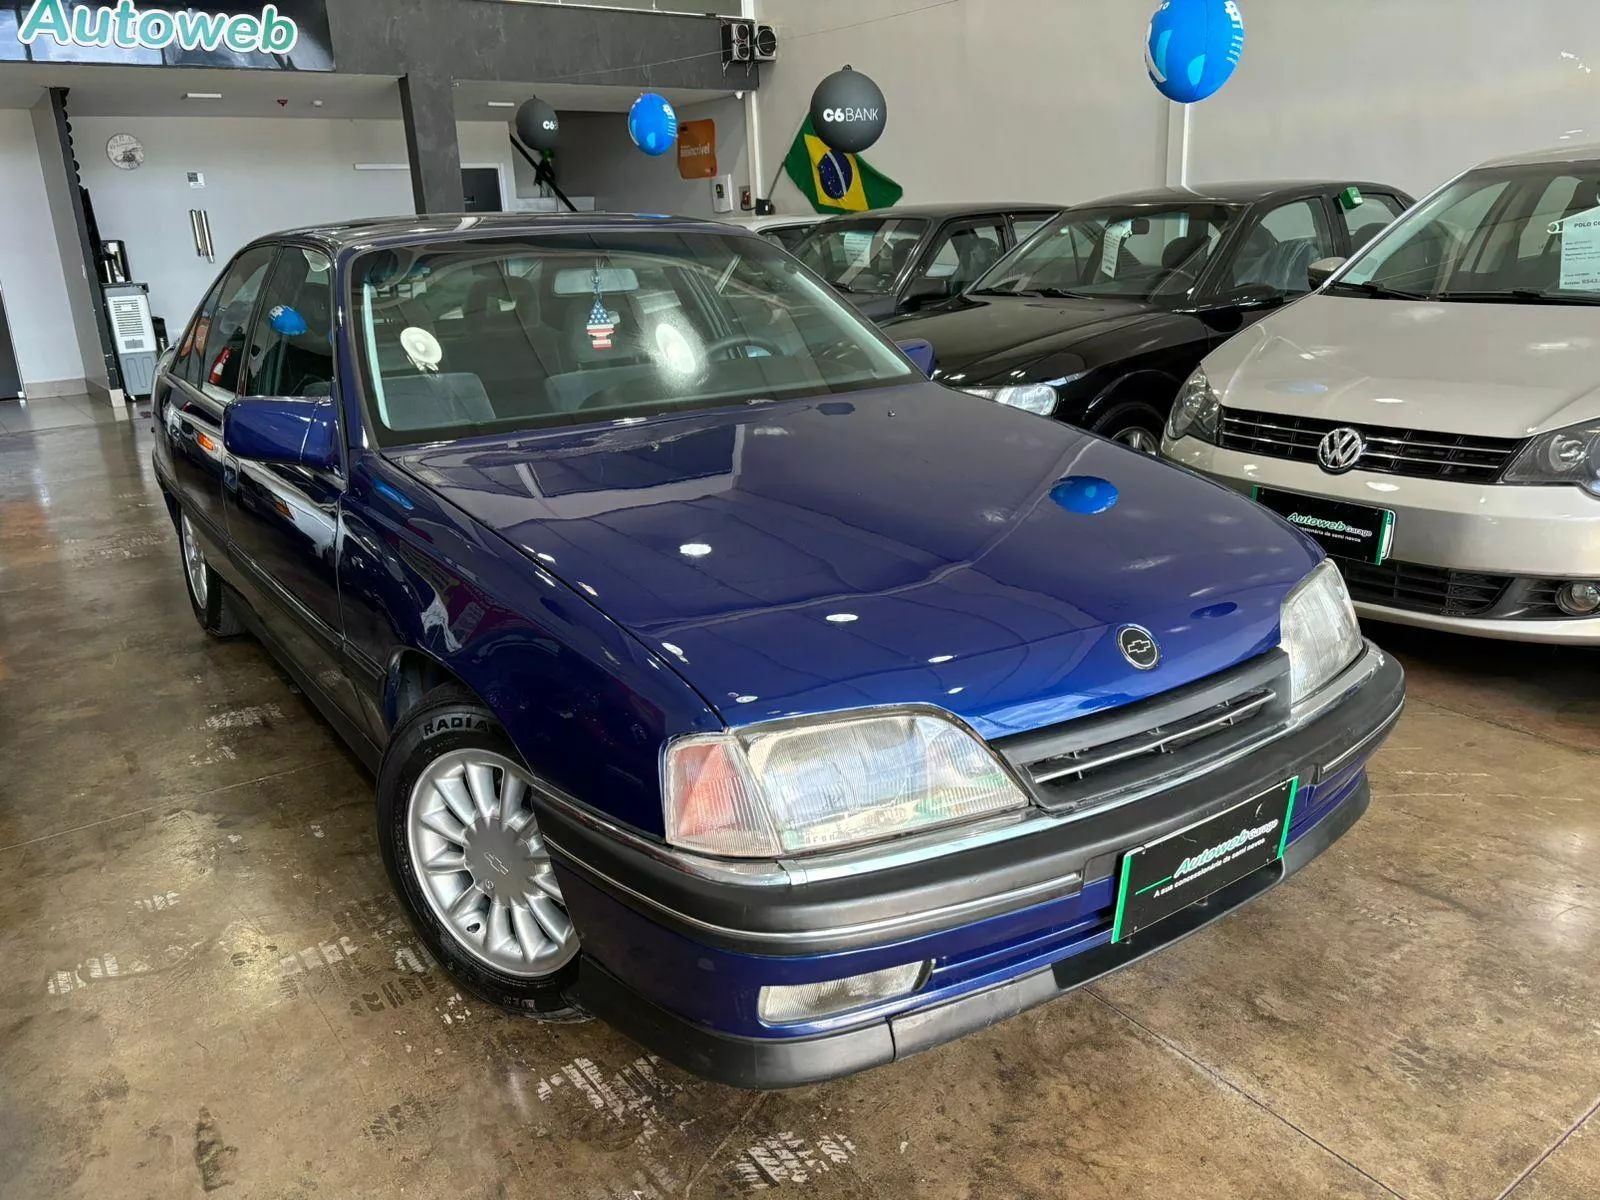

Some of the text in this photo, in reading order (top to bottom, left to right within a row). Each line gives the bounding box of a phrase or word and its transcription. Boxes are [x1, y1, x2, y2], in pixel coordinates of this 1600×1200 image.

[17, 0, 298, 53] Autoweb
[1287, 512, 1346, 532] Autoweb
[1173, 828, 1250, 879] Autoweb
[1153, 889, 1161, 898] A
